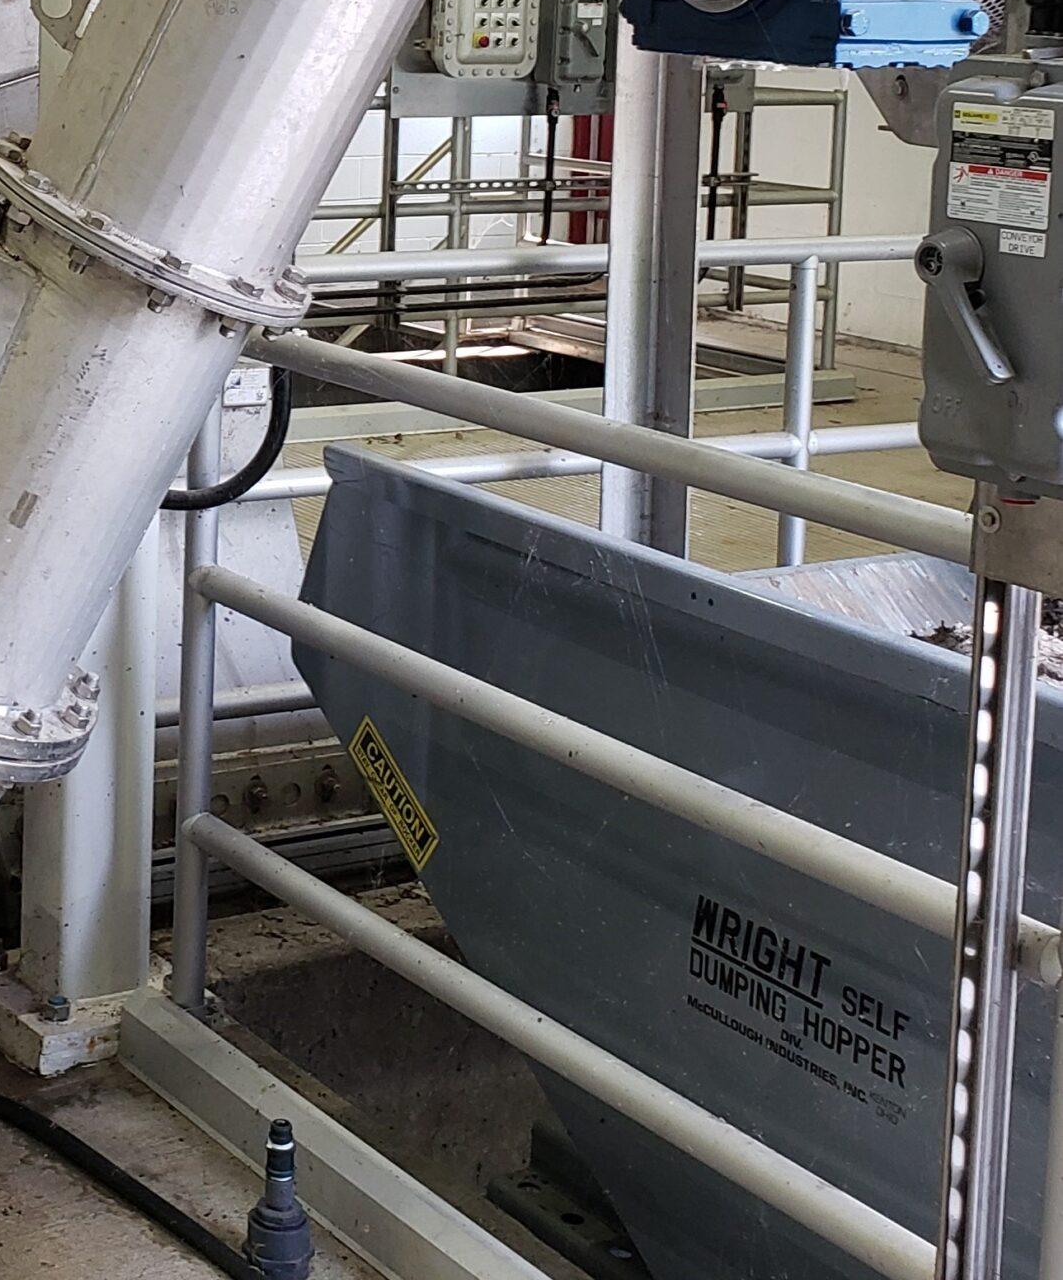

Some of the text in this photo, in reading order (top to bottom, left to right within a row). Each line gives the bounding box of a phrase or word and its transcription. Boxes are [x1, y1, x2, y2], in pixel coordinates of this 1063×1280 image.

[995, 167, 1023, 177] DANGER
[1001, 231, 1043, 244] CONVEYOR
[1008, 243, 1035, 255] DRIVE
[366, 741, 425, 840] CAUTION
[693, 894, 911, 1041] WRIGHT SELF
[689, 946, 907, 1089] DUMPING HOPPER
[780, 1029, 804, 1051] DIV.
[688, 994, 763, 1046] McCULLOUGH
[765, 1037, 840, 1090] INDUSTRIES,
[843, 1081, 868, 1105] INC.
